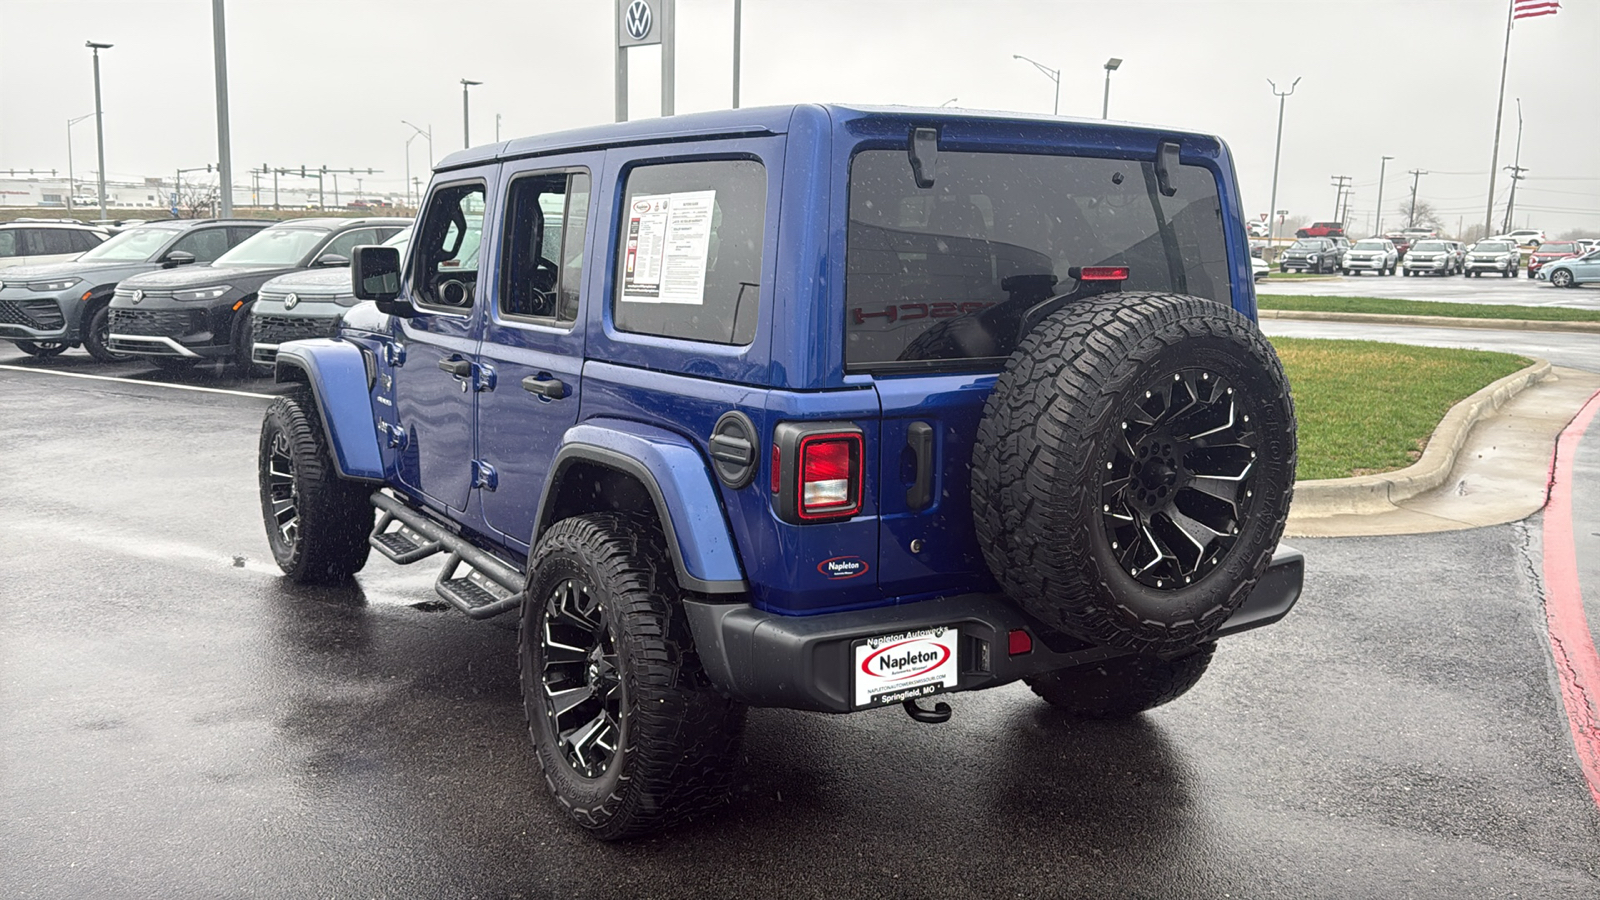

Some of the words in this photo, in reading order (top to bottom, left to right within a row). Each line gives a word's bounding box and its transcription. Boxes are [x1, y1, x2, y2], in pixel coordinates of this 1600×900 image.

[828, 561, 859, 571] Napleton
[867, 633, 904, 646] Napleton
[880, 650, 938, 670] Napleton
[881, 688, 922, 703] Springfield,
[922, 685, 935, 694] MO
